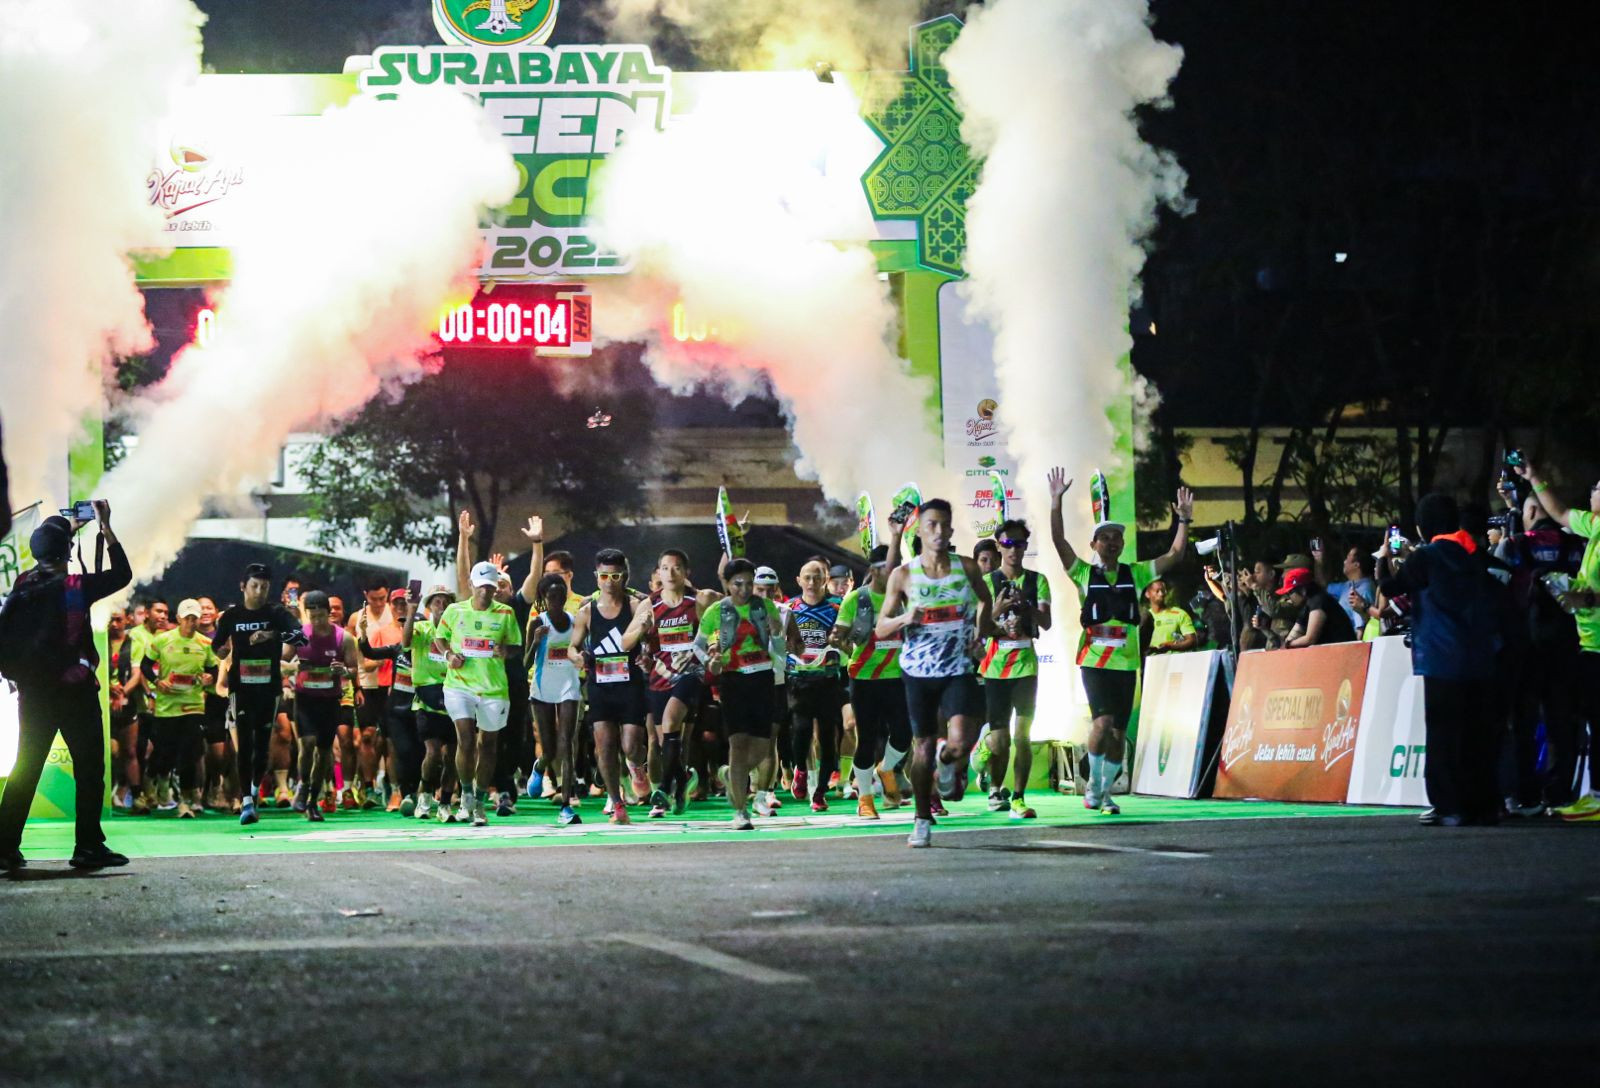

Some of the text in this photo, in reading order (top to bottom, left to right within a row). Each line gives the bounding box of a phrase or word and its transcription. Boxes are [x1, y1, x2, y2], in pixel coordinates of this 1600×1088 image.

[367, 52, 664, 85] SURABAYA
[491, 236, 626, 268] 202
[440, 303, 567, 342] 00:00:04
[236, 622, 269, 632] RIOT
[1265, 694, 1322, 721] SPECIAL MIX
[1254, 742, 1317, 761] Jelas lebih enak
[1390, 744, 1426, 778] CIT
